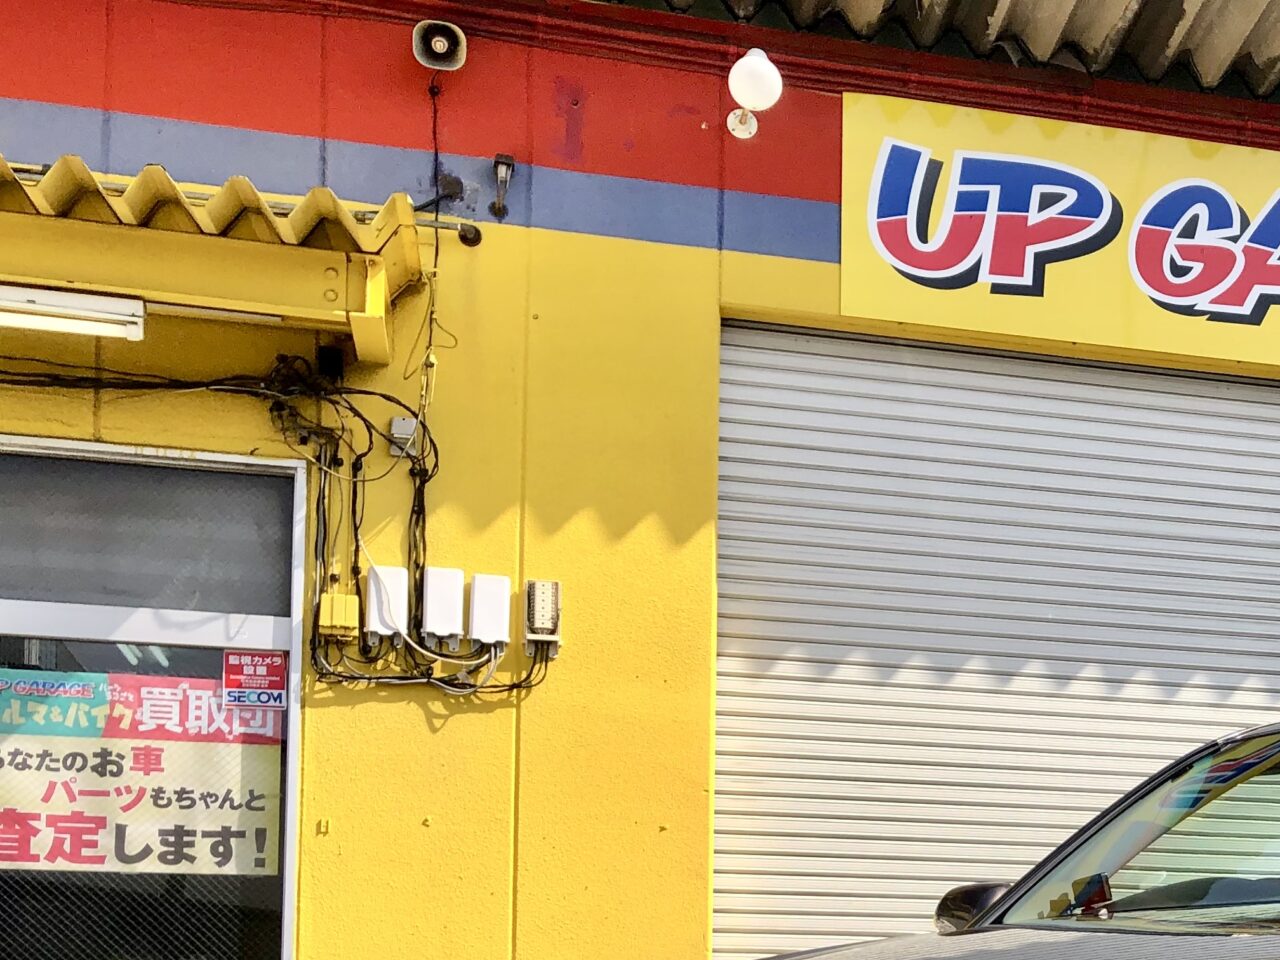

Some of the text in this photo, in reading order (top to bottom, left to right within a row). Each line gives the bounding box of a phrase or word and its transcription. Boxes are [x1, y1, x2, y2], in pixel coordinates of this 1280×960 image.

[868, 137, 1122, 297] UP
[12, 679, 95, 698] GARAGE
[227, 690, 283, 705] SECOM
[0, 746, 165, 777] なたのお車
